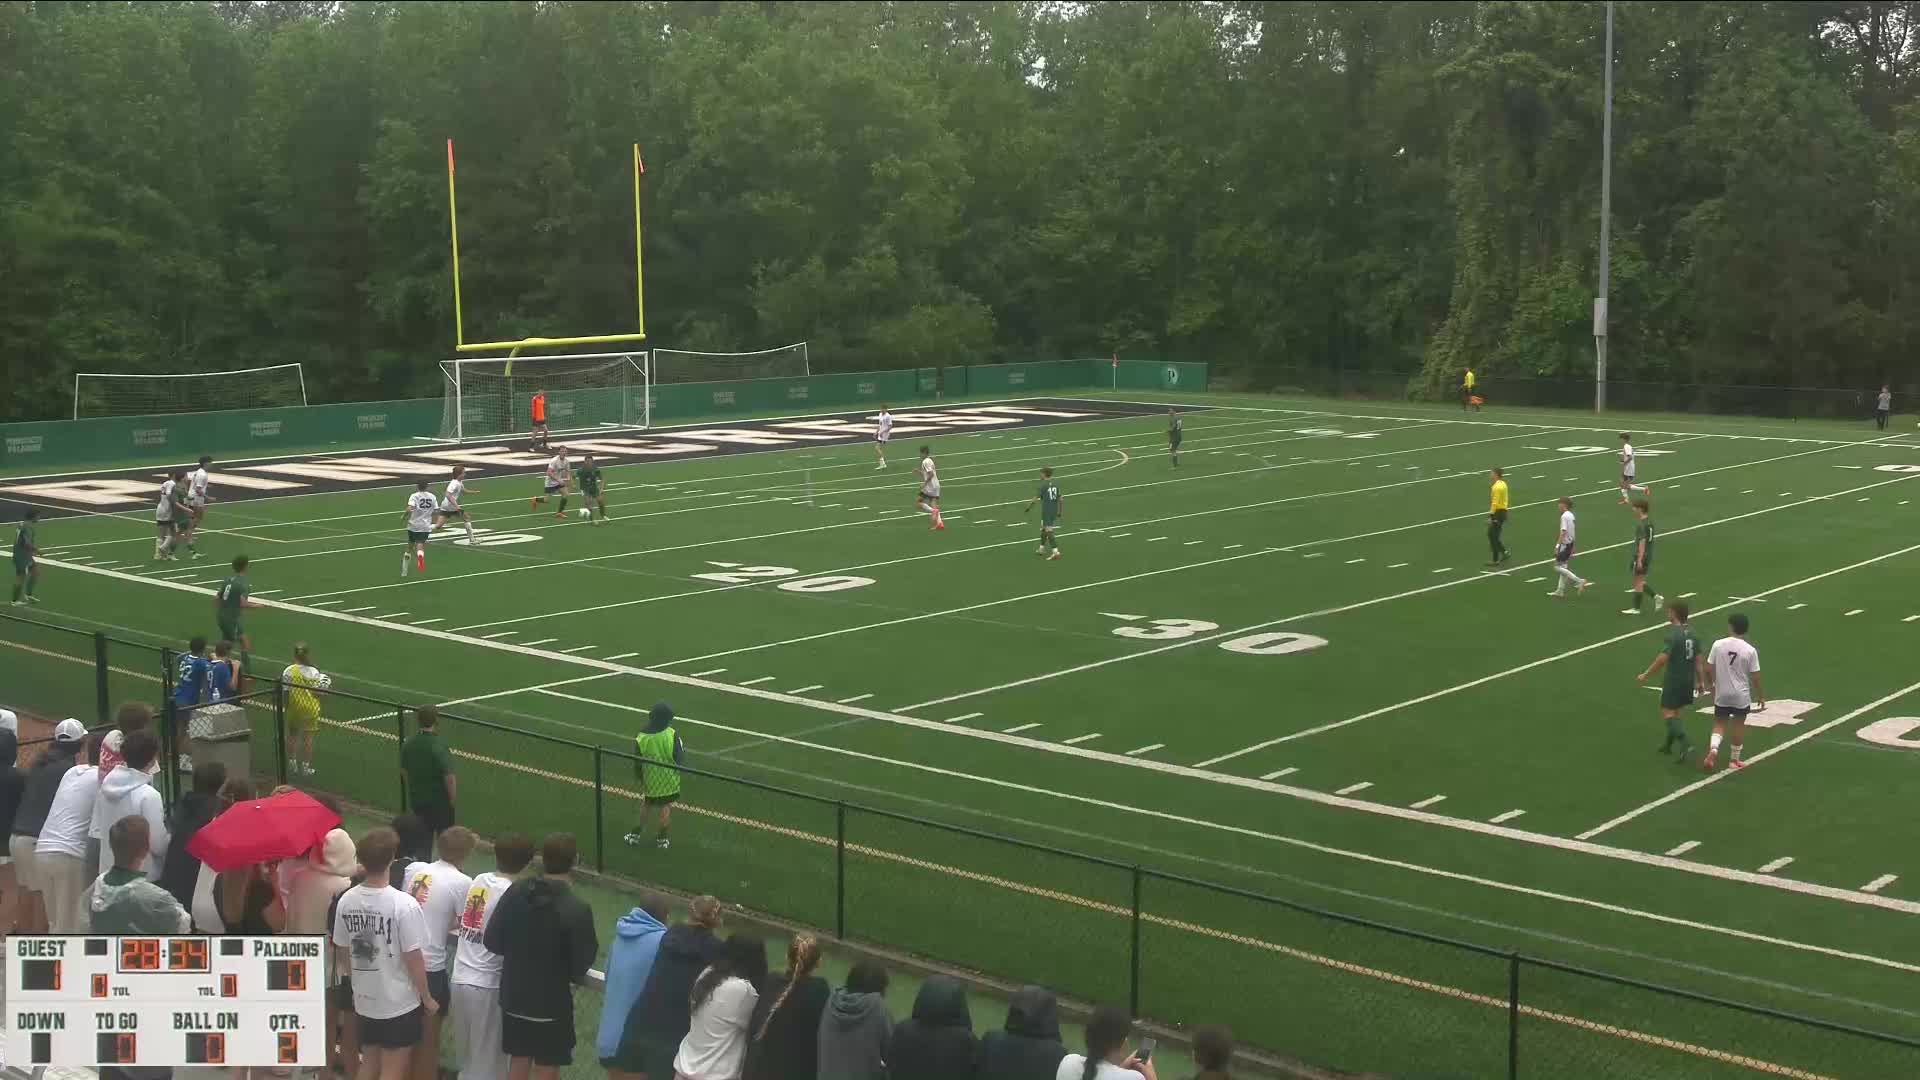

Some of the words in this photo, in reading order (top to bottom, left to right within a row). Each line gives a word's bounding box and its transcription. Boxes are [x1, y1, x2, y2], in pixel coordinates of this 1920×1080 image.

[419, 498, 433, 509] 25
[1727, 651, 1738, 666] 7
[386, 917, 393, 945] 1
